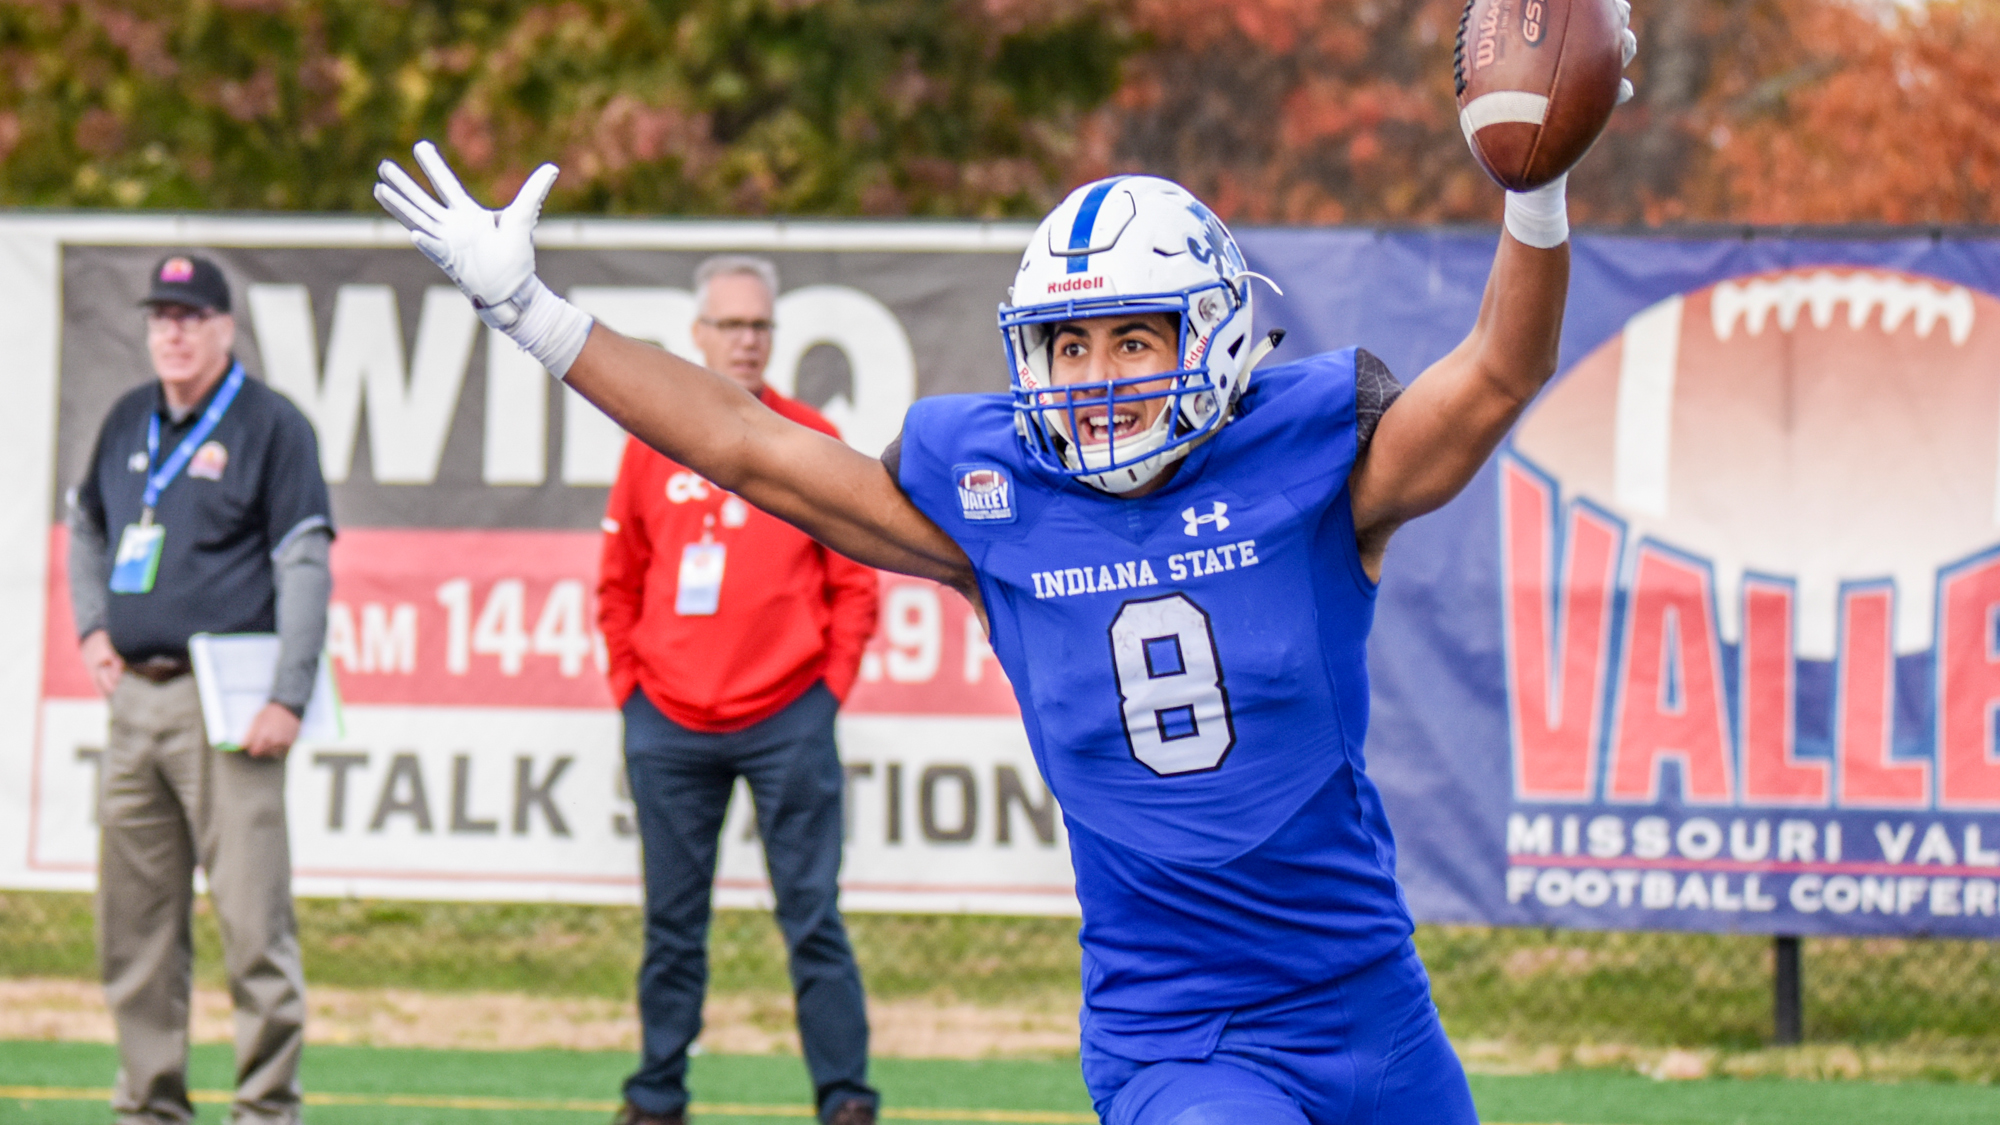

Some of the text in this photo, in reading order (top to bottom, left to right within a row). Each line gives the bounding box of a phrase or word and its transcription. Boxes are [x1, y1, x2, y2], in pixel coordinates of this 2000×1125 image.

[1523, 0, 1544, 42] GS
[1047, 276, 1104, 294] Riddell
[248, 284, 917, 487] WIQ
[958, 481, 1009, 510] VALLEY
[1031, 540, 1259, 599] INDIANA STATE
[327, 602, 418, 674] AM
[435, 577, 610, 678] 144
[1107, 591, 1236, 778] 8
[311, 751, 577, 840] TALK
[1507, 813, 2000, 867] MISSOURI VAL
[1507, 866, 1774, 912] FOOTBALL
